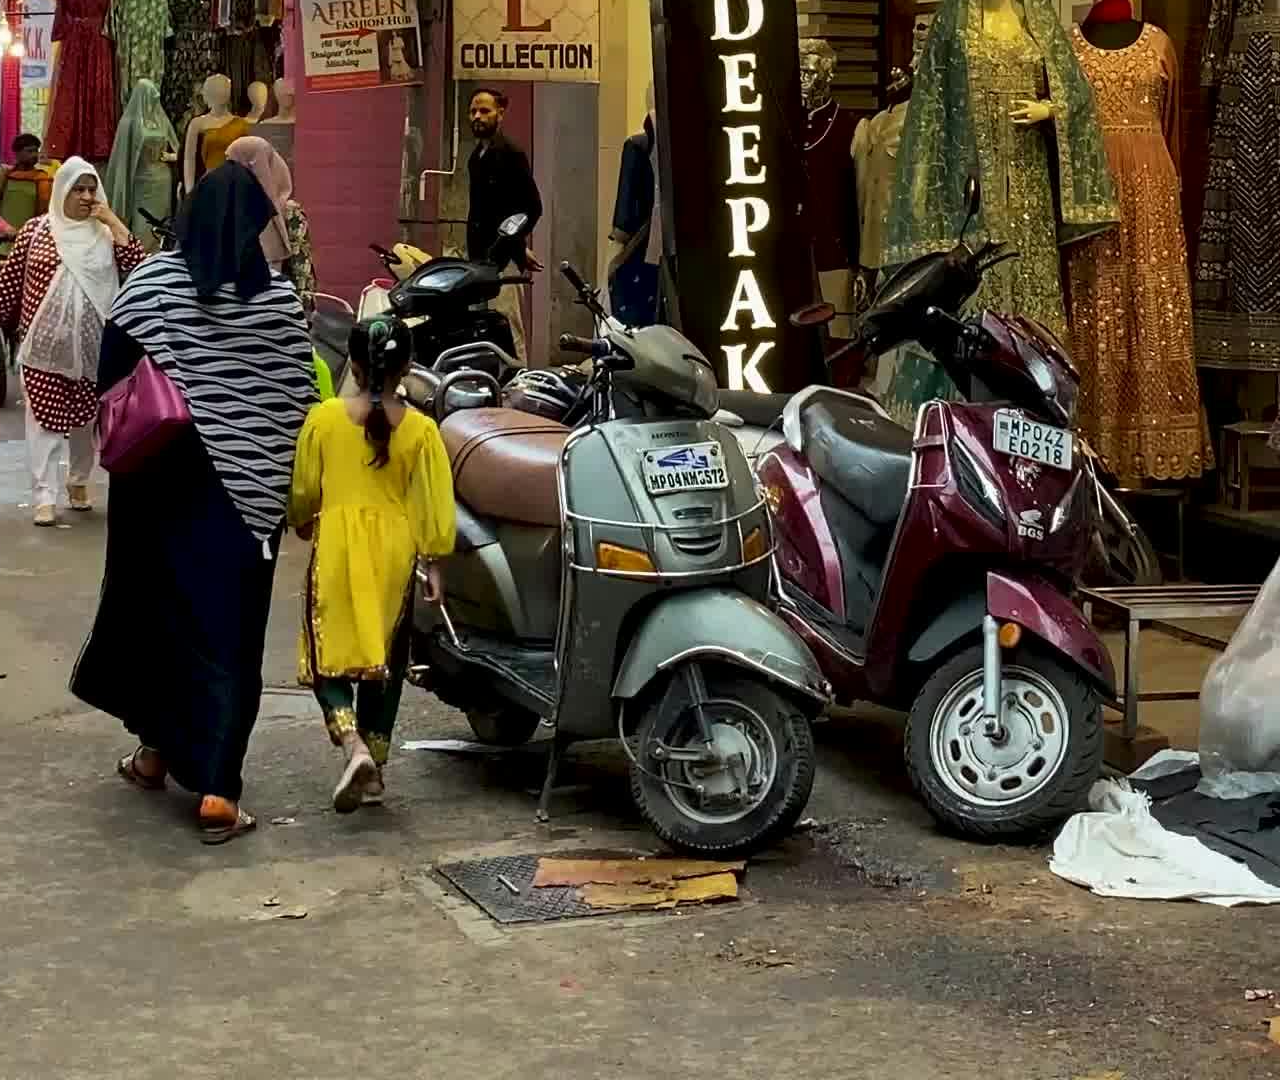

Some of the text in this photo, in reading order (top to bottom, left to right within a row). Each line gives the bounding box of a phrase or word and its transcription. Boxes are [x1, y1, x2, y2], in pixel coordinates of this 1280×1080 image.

[336, 15, 412, 31] FASHION HUB
[459, 42, 593, 69] COLLECTION
[1008, 436, 1063, 465] E0218
